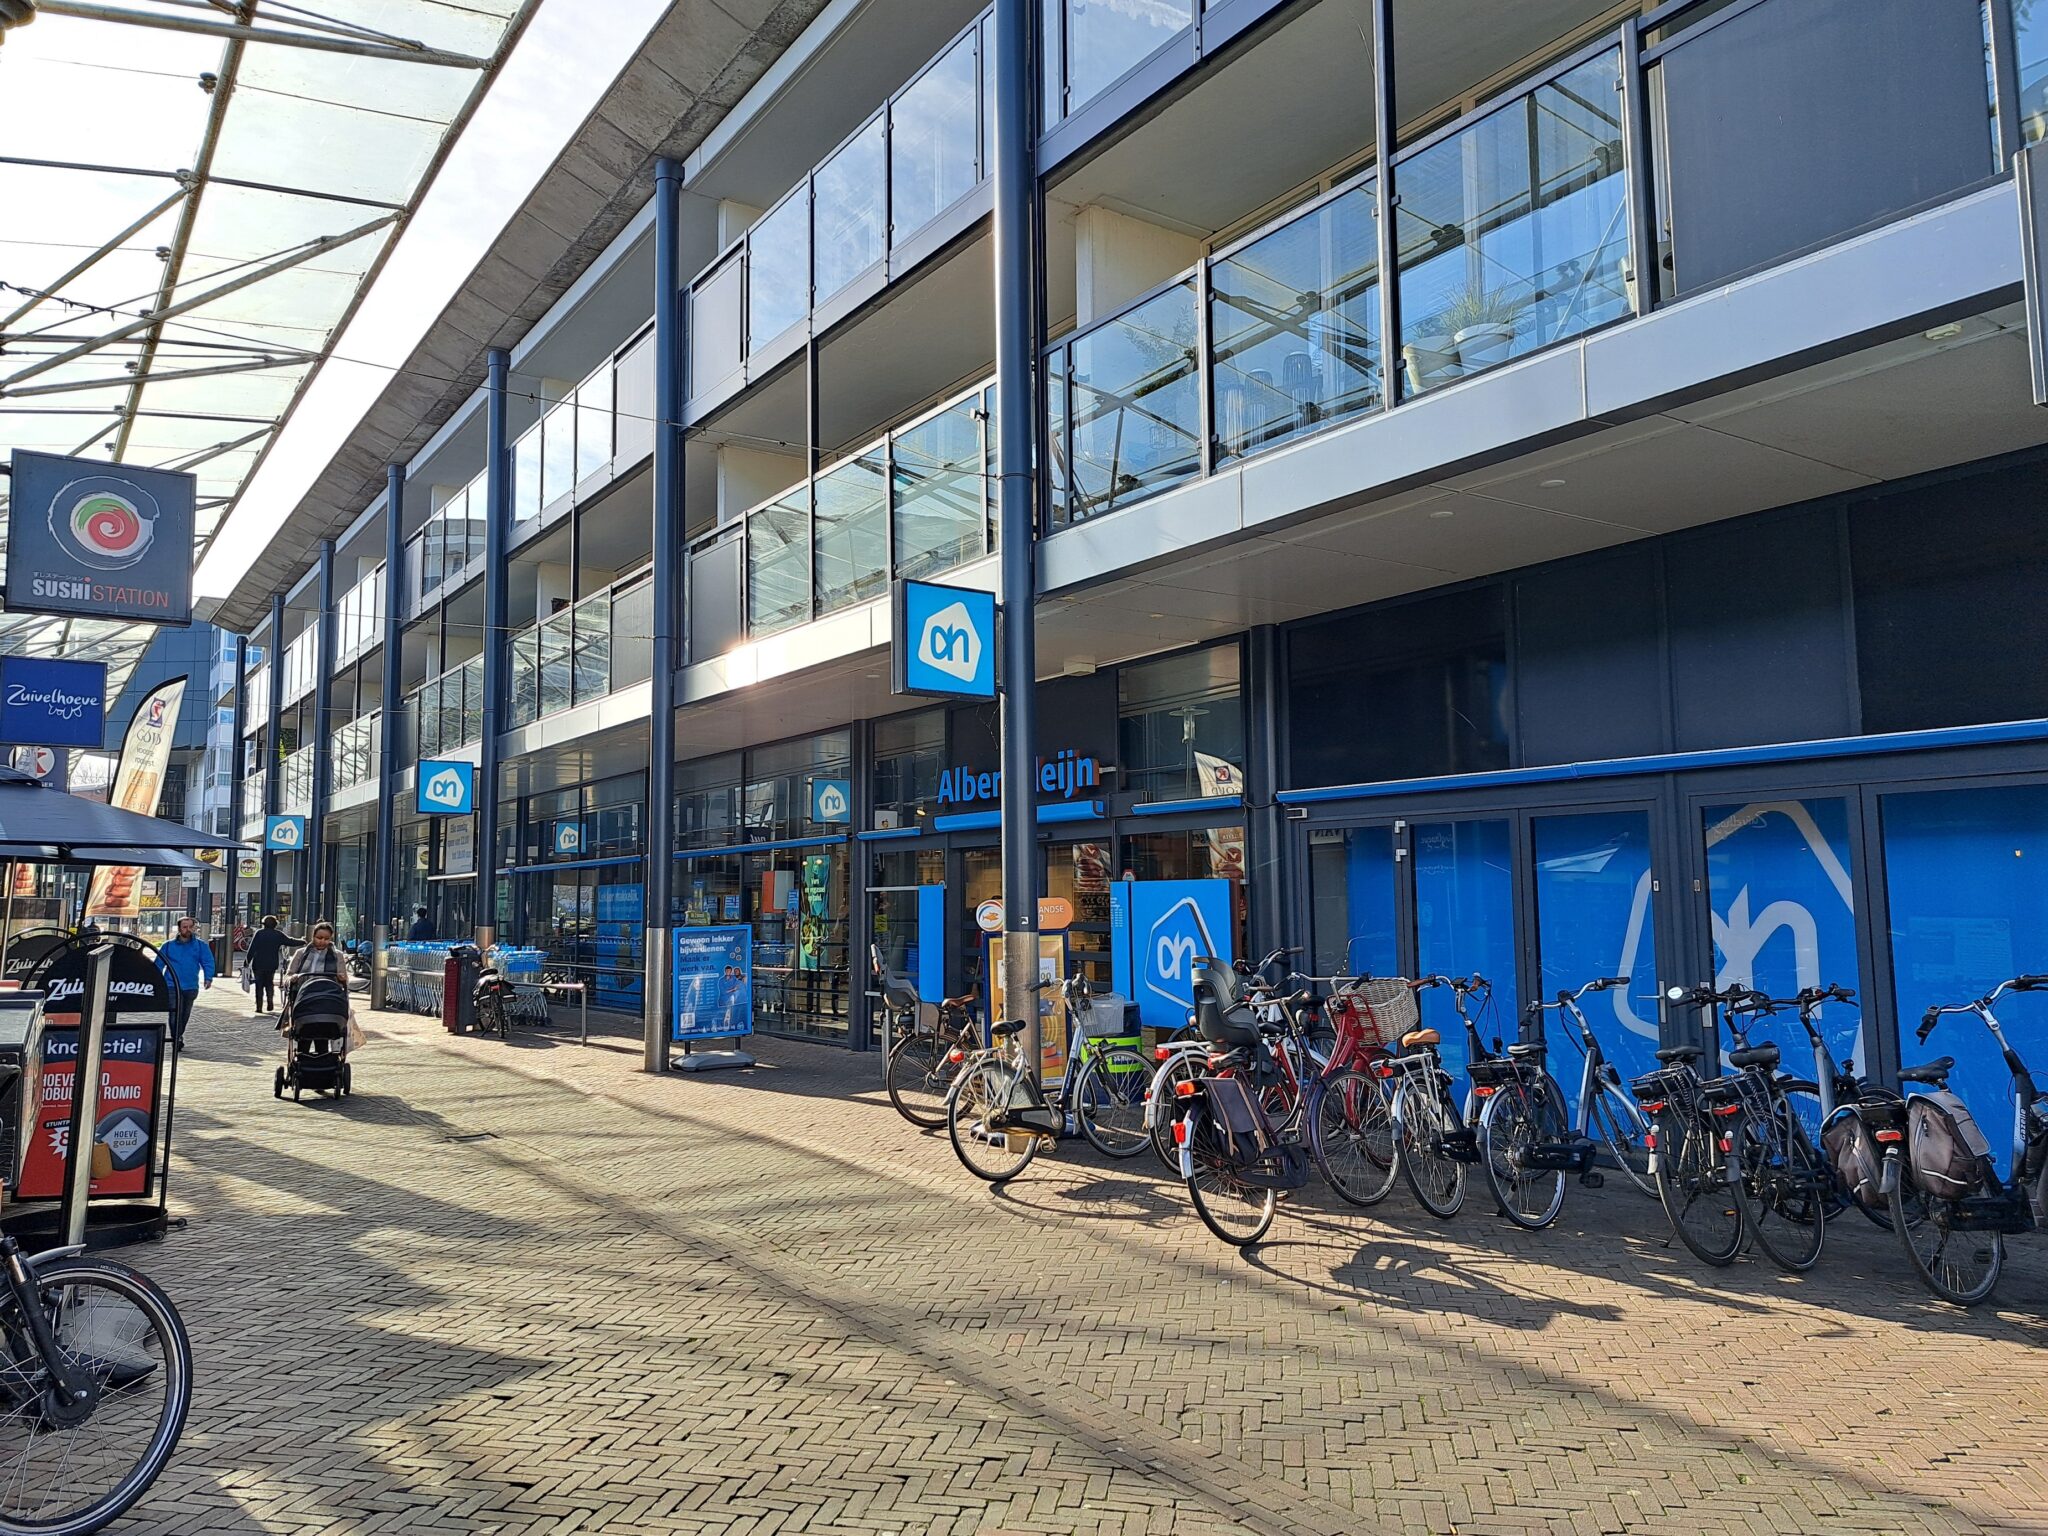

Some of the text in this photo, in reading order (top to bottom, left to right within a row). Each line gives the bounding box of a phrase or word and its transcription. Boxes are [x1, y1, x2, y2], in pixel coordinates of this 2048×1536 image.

[93, 585, 168, 607] STATION
[7, 684, 100, 706] Zuivelhoeve
[937, 749, 1093, 804] Alber eijn
[1039, 905, 1064, 913] ANDSE
[712, 935, 735, 943] lekker
[103, 1086, 141, 1100] ROMIG
[114, 1130, 138, 1138] HOEVE
[113, 1139, 137, 1149] goud
